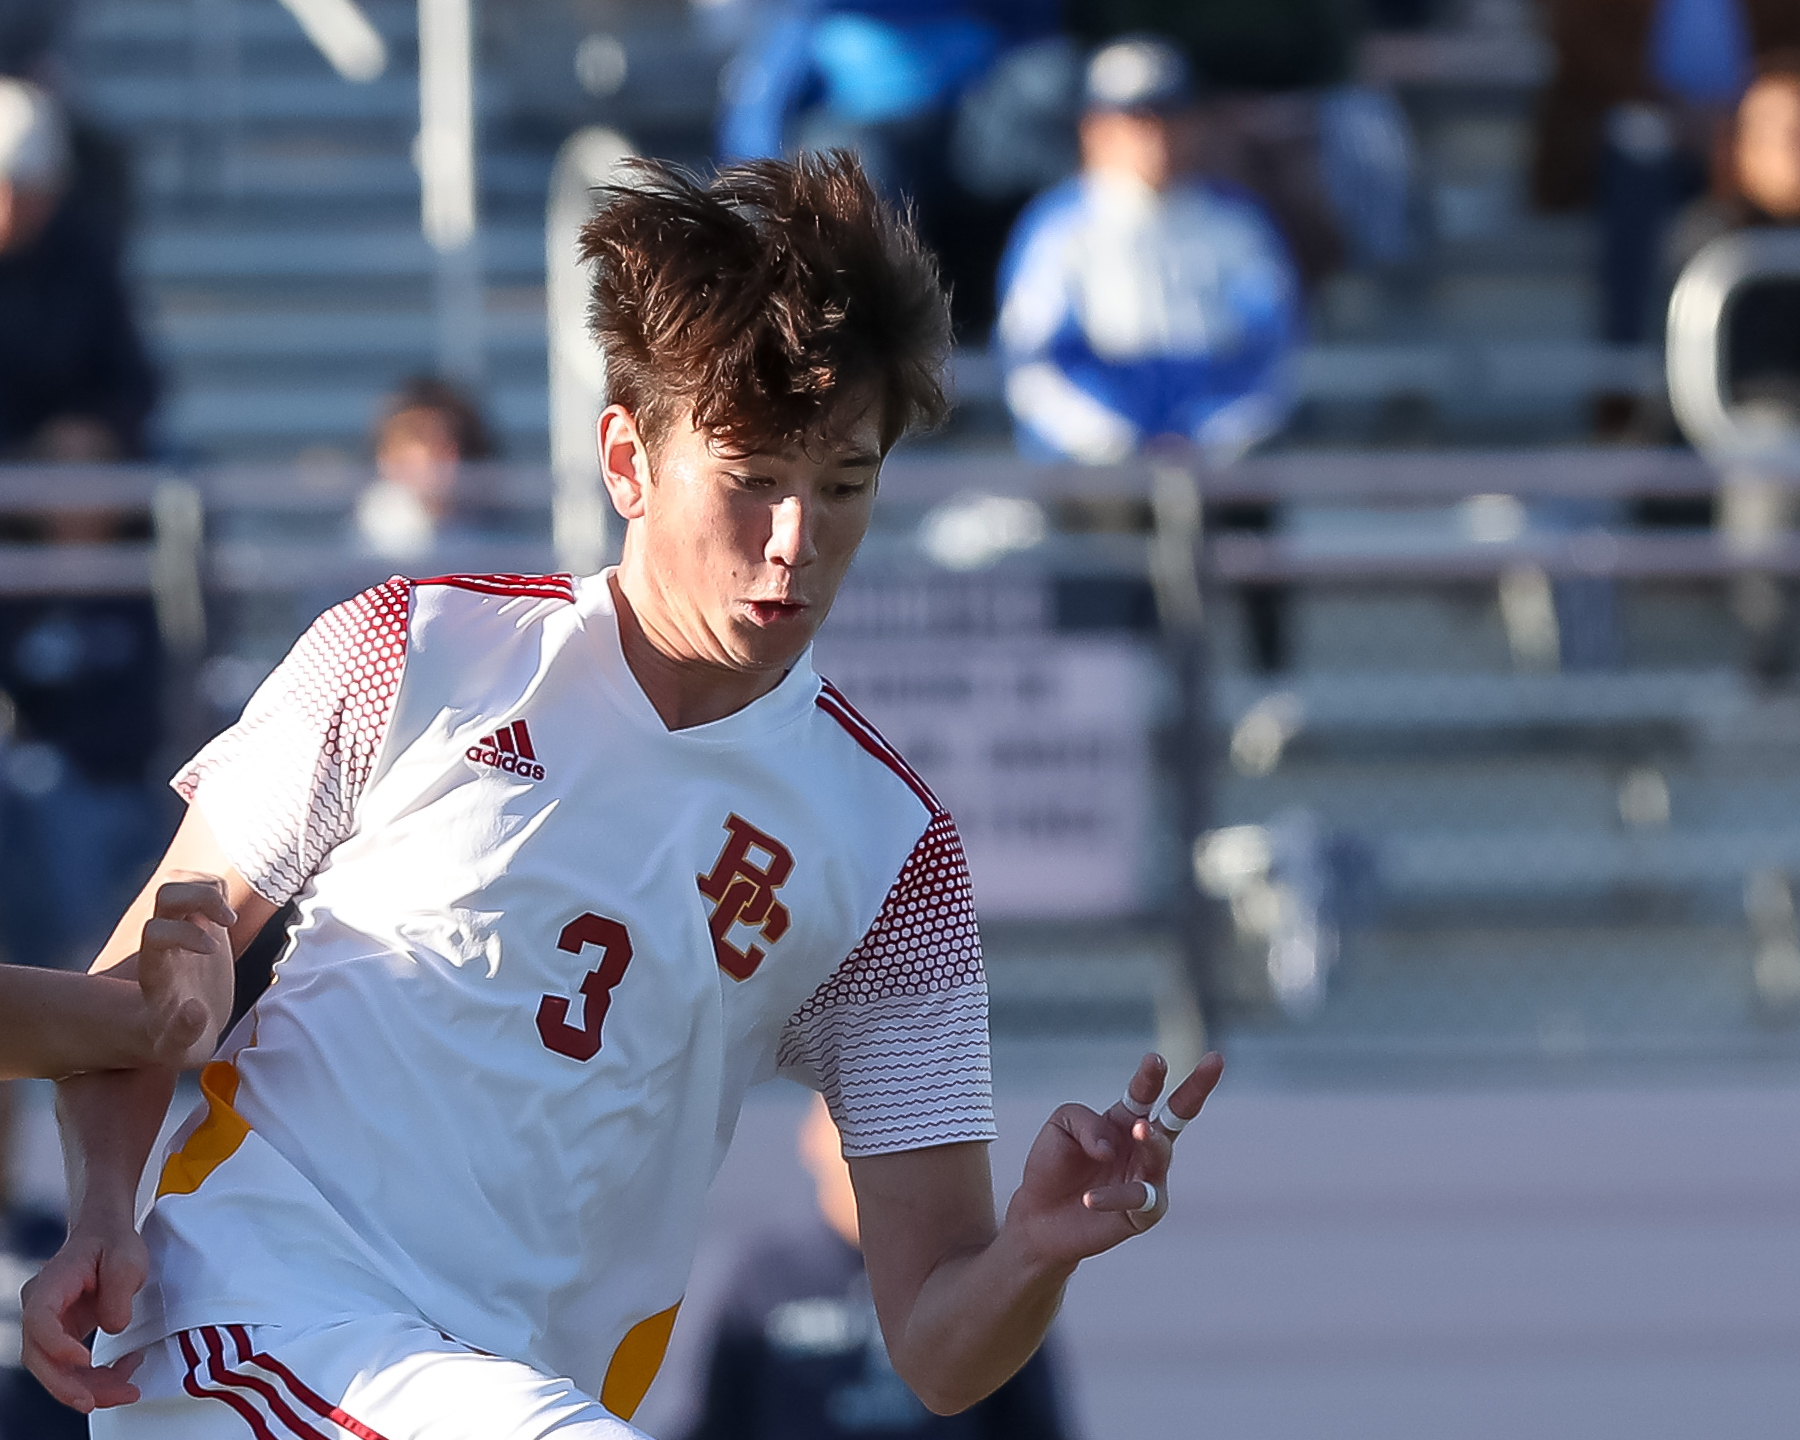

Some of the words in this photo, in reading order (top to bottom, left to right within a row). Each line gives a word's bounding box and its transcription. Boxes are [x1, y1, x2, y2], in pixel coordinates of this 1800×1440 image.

[465, 746, 546, 781] adidas
[696, 811, 797, 984] BC
[535, 911, 634, 1064] 3
